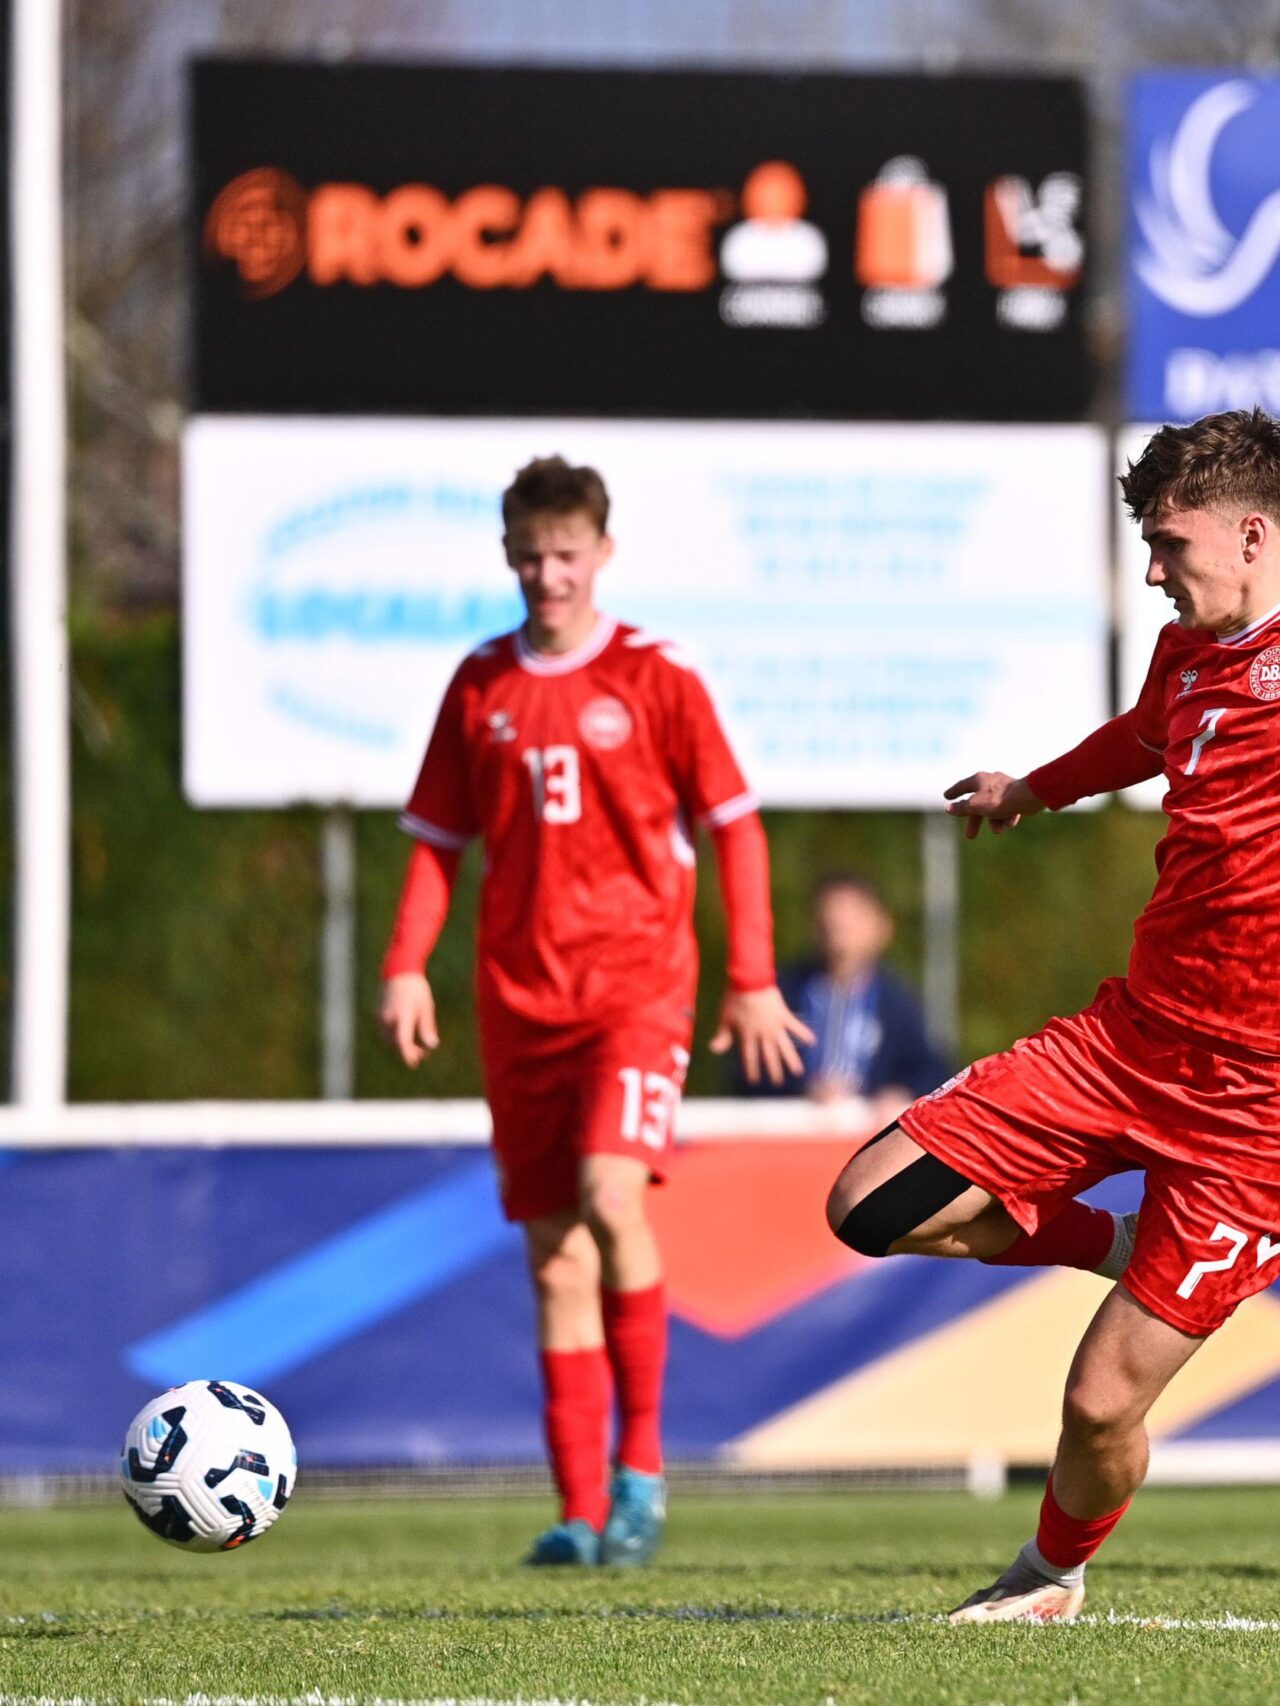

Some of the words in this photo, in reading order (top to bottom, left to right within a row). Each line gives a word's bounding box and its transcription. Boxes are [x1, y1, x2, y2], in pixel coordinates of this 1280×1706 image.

[305, 183, 717, 292] ROCADE
[1183, 707, 1228, 774] 7
[521, 744, 582, 824] 13
[618, 1066, 682, 1151] 13
[1176, 1221, 1249, 1300] 7
